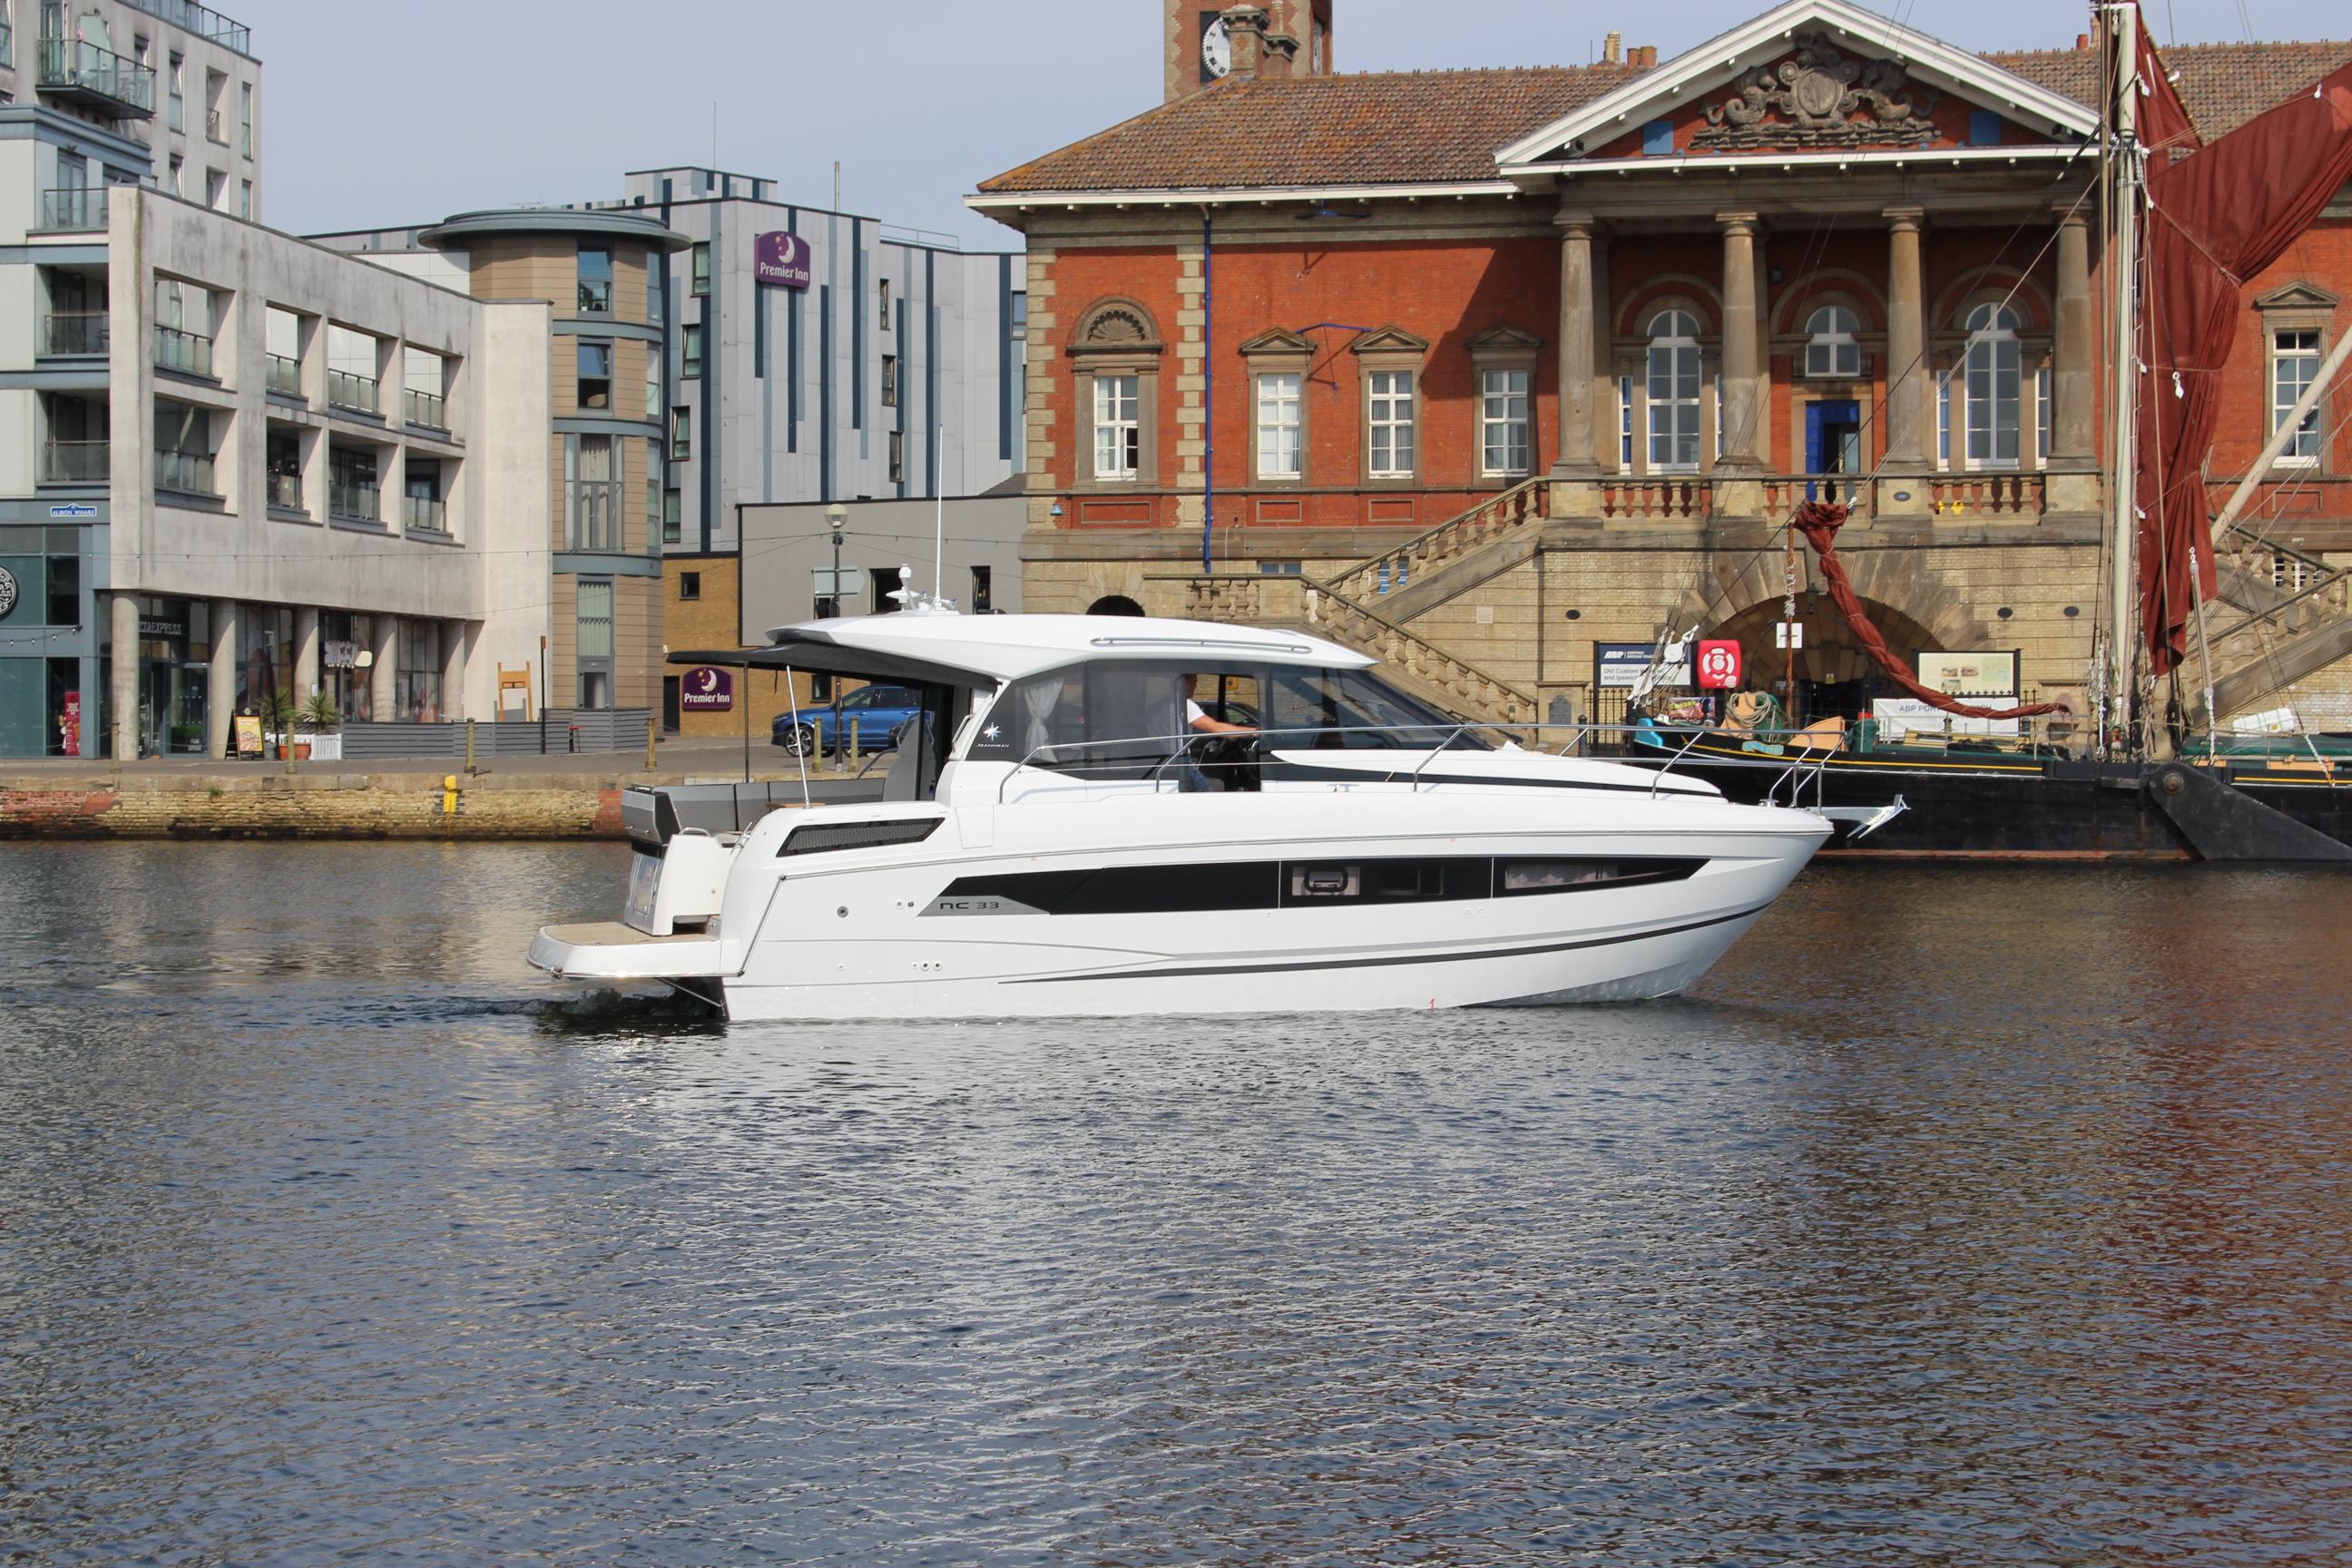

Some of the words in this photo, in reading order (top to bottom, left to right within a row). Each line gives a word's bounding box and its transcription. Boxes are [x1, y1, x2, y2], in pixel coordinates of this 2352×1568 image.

[760, 261, 795, 279] Premier
[795, 267, 809, 281] Inn
[684, 692, 717, 703] Premier
[717, 692, 730, 703] Inn
[1918, 704, 1940, 712] POR
